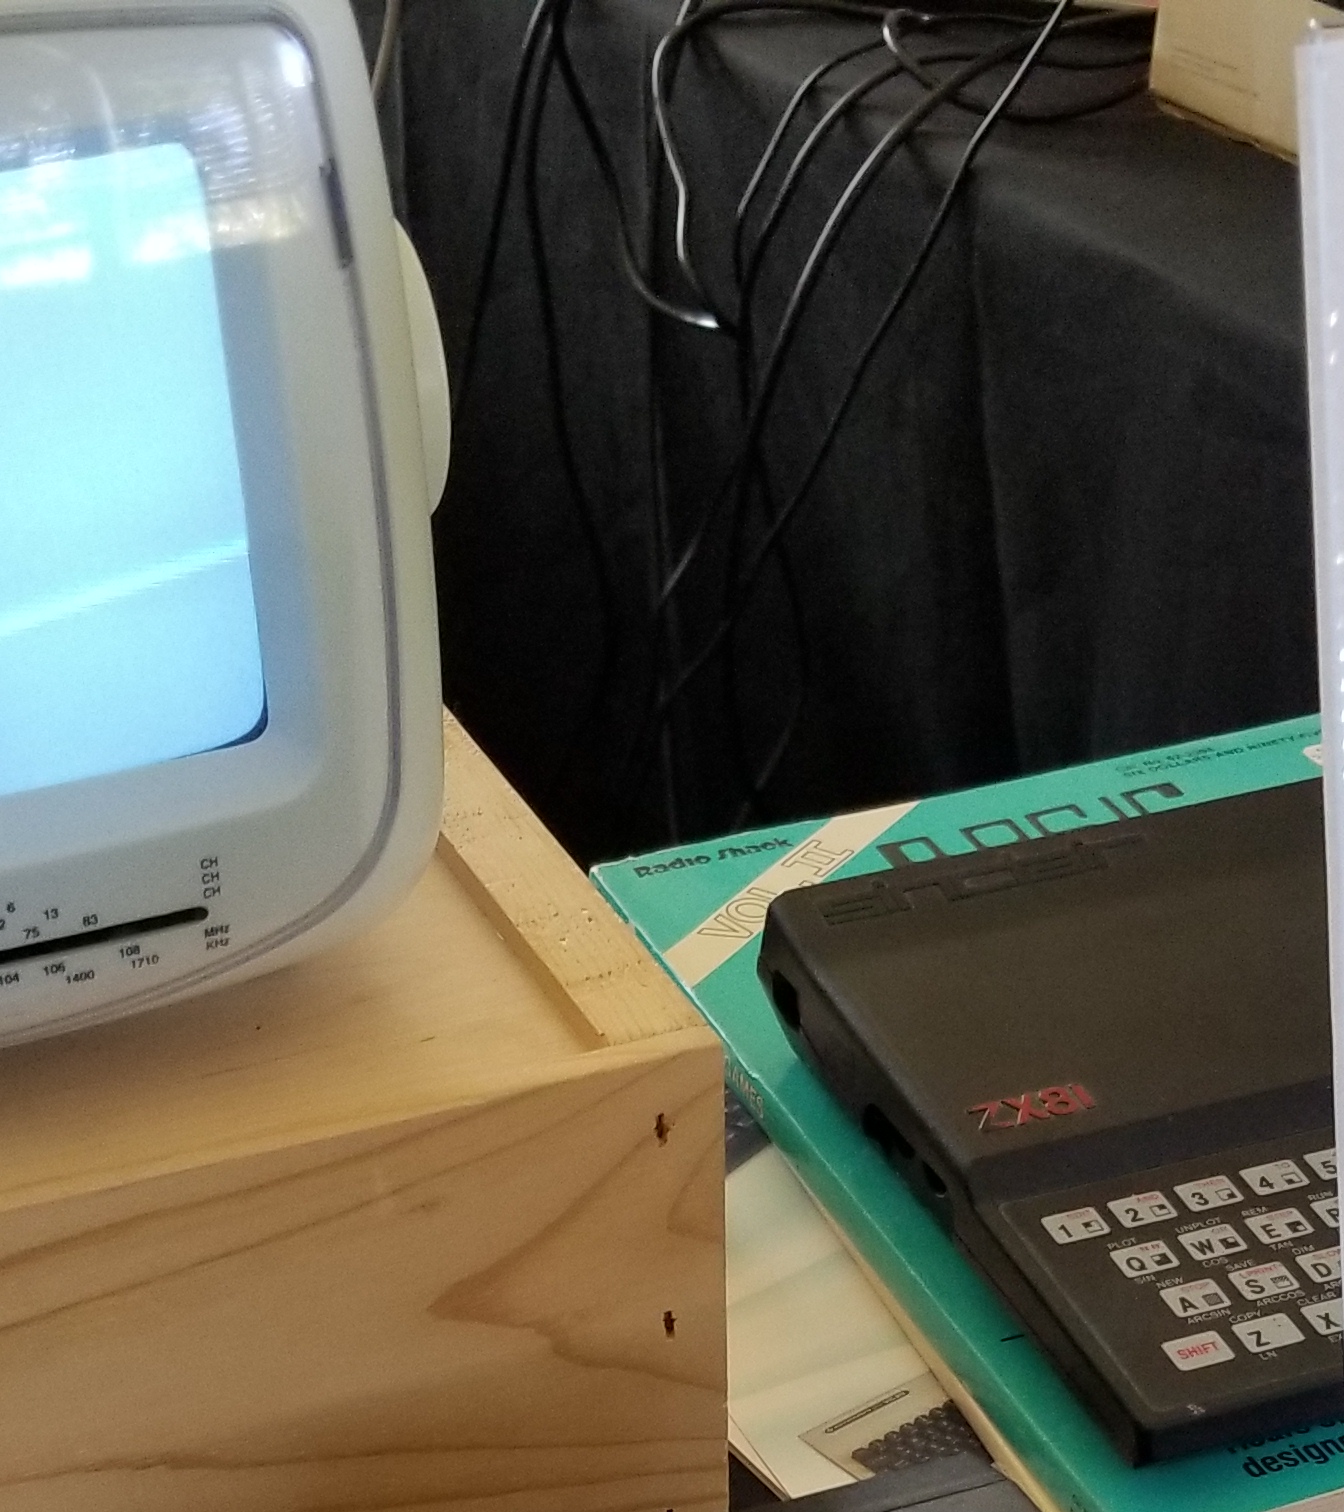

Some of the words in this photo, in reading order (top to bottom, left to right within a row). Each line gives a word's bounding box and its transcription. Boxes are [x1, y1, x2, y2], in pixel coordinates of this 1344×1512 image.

[633, 854, 711, 878] Radio
[718, 837, 793, 861] Shack
[44, 908, 58, 920] 13
[23, 927, 39, 939] 75
[131, 954, 159, 969] 1710
[968, 1084, 1096, 1131] ZX81
[1177, 1341, 1219, 1360] SHIFT
